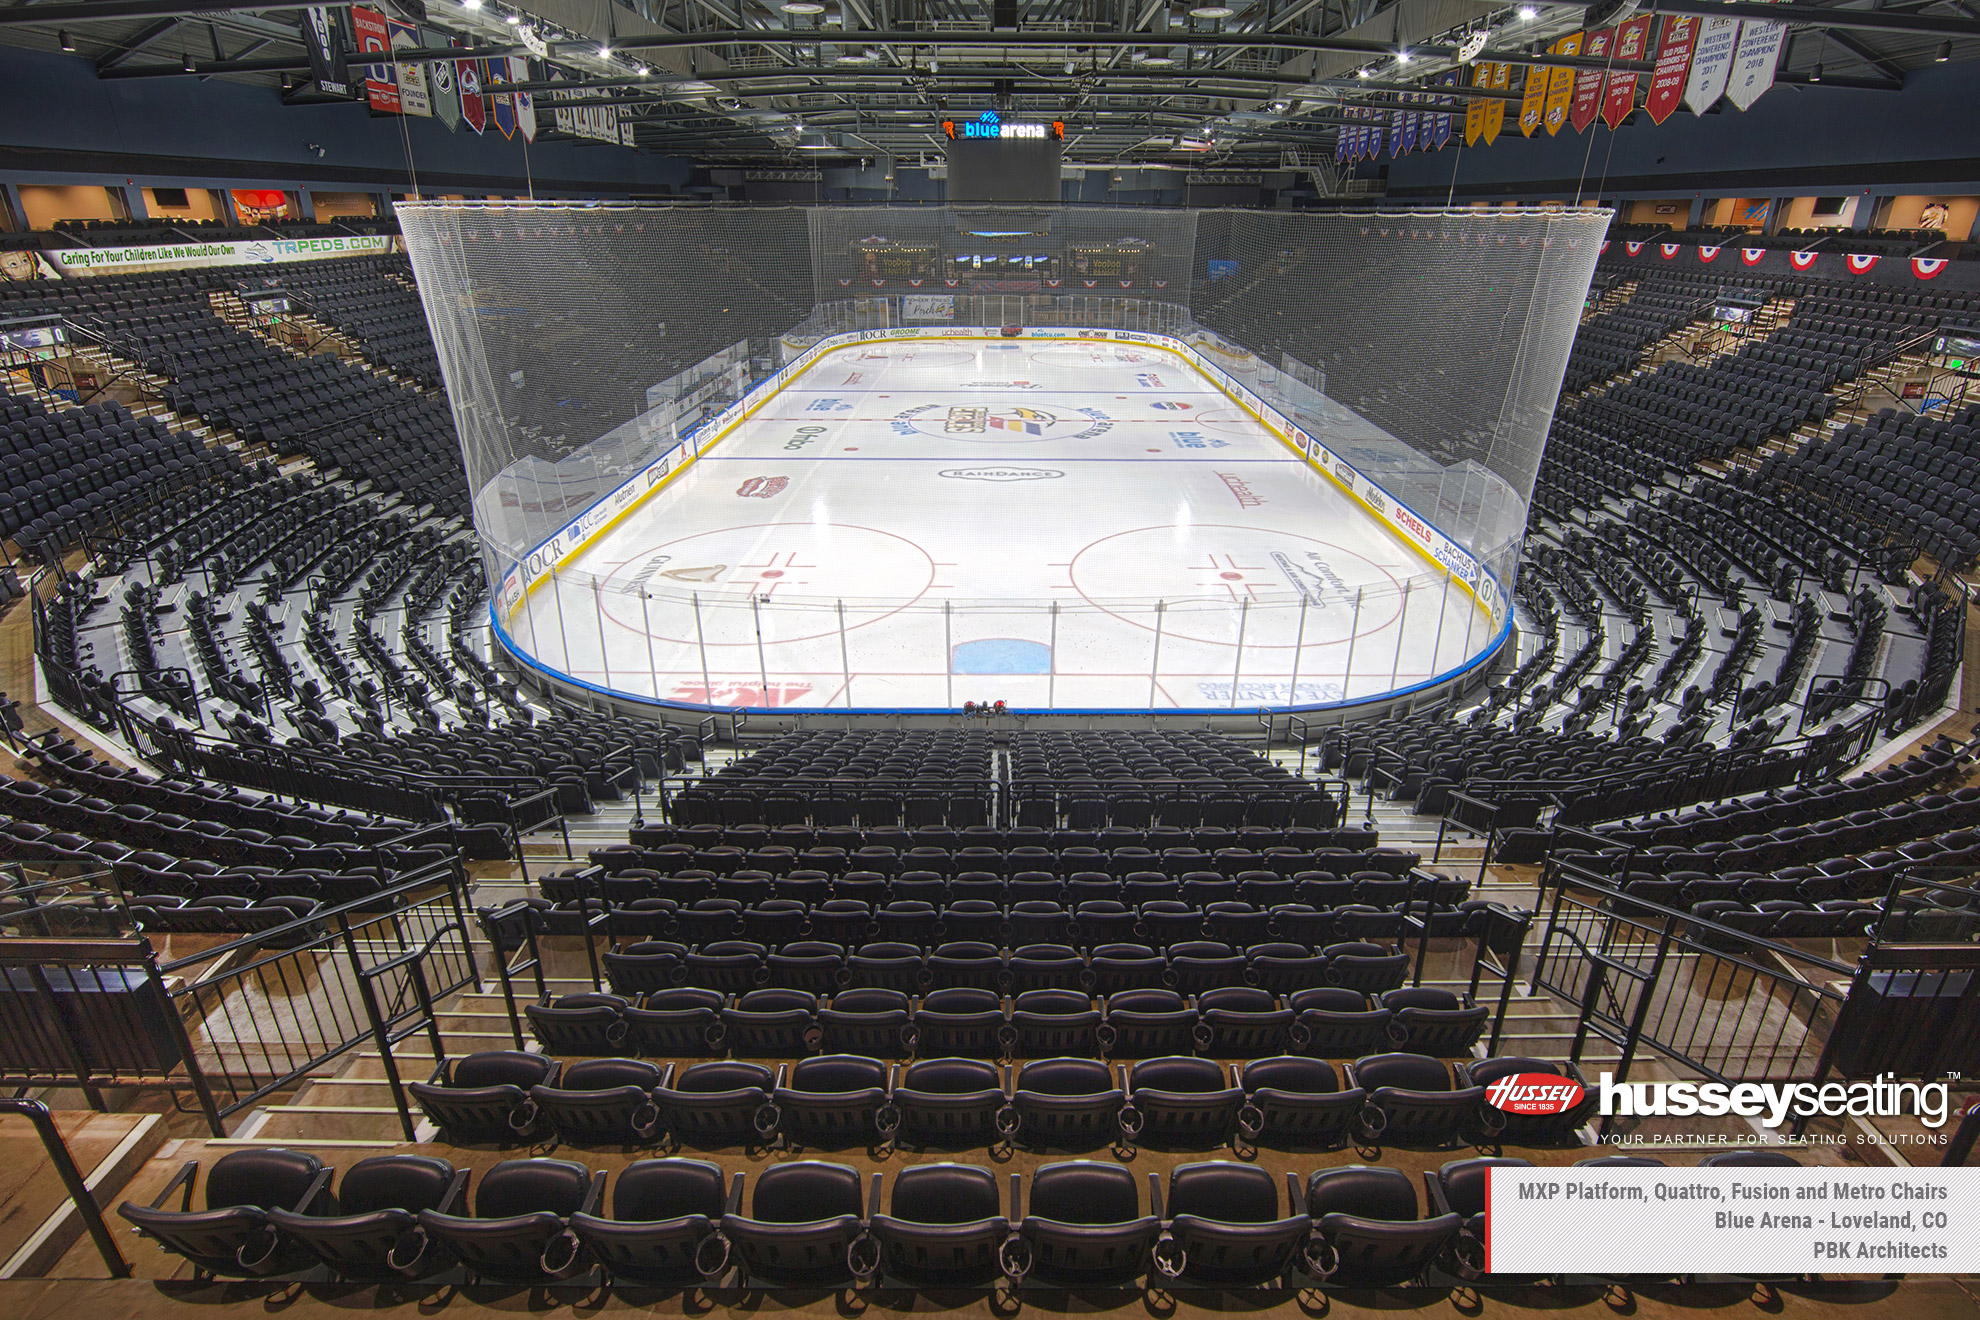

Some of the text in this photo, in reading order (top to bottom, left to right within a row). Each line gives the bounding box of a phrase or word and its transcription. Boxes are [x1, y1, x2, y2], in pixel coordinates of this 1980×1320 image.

[354, 17, 386, 35] BACKSTROM
[1749, 23, 1779, 36] WESTERN
[1703, 32, 1731, 45] WESTERN
[1741, 33, 1780, 48] CONFERENCE
[1697, 41, 1733, 56] CONFERENCE
[1738, 44, 1776, 59] CHAMPIONS
[1695, 52, 1729, 65] CHAMPIONS
[1745, 58, 1763, 69] 2018
[1656, 63, 1686, 76] CHAMPIONS
[1701, 65, 1718, 75] 2017
[320, 80, 347, 95] STEWART
[1655, 76, 1680, 88] 2008-09
[272, 237, 384, 255] TRPEDS.COM
[60, 252, 90, 267] Caring
[91, 250, 104, 263] For
[104, 249, 123, 262] Your
[124, 247, 157, 261] Children
[158, 247, 172, 259] Like
[173, 247, 185, 258] We
[184, 245, 207, 258] Would
[208, 245, 220, 256] Our
[220, 245, 235, 256] Own
[54, 328, 65, 342] Q
[865, 330, 886, 340] OCR
[942, 328, 972, 336] uchealth
[1936, 338, 1945, 350] G
[614, 484, 636, 506] Nutrien
[1219, 473, 1268, 507] uchealth
[580, 512, 594, 534] ICC
[1395, 507, 1432, 543] SCHEELS
[529, 538, 564, 577] OCR
[1304, 550, 1319, 561] Air
[1443, 542, 1471, 569] BACHUS
[1434, 547, 1469, 581] SCHANKER
[621, 556, 671, 594] GUINNESS
[740, 680, 780, 689] helpful
[667, 687, 813, 707] ACE
[1202, 690, 1343, 701] EYE CENTER
